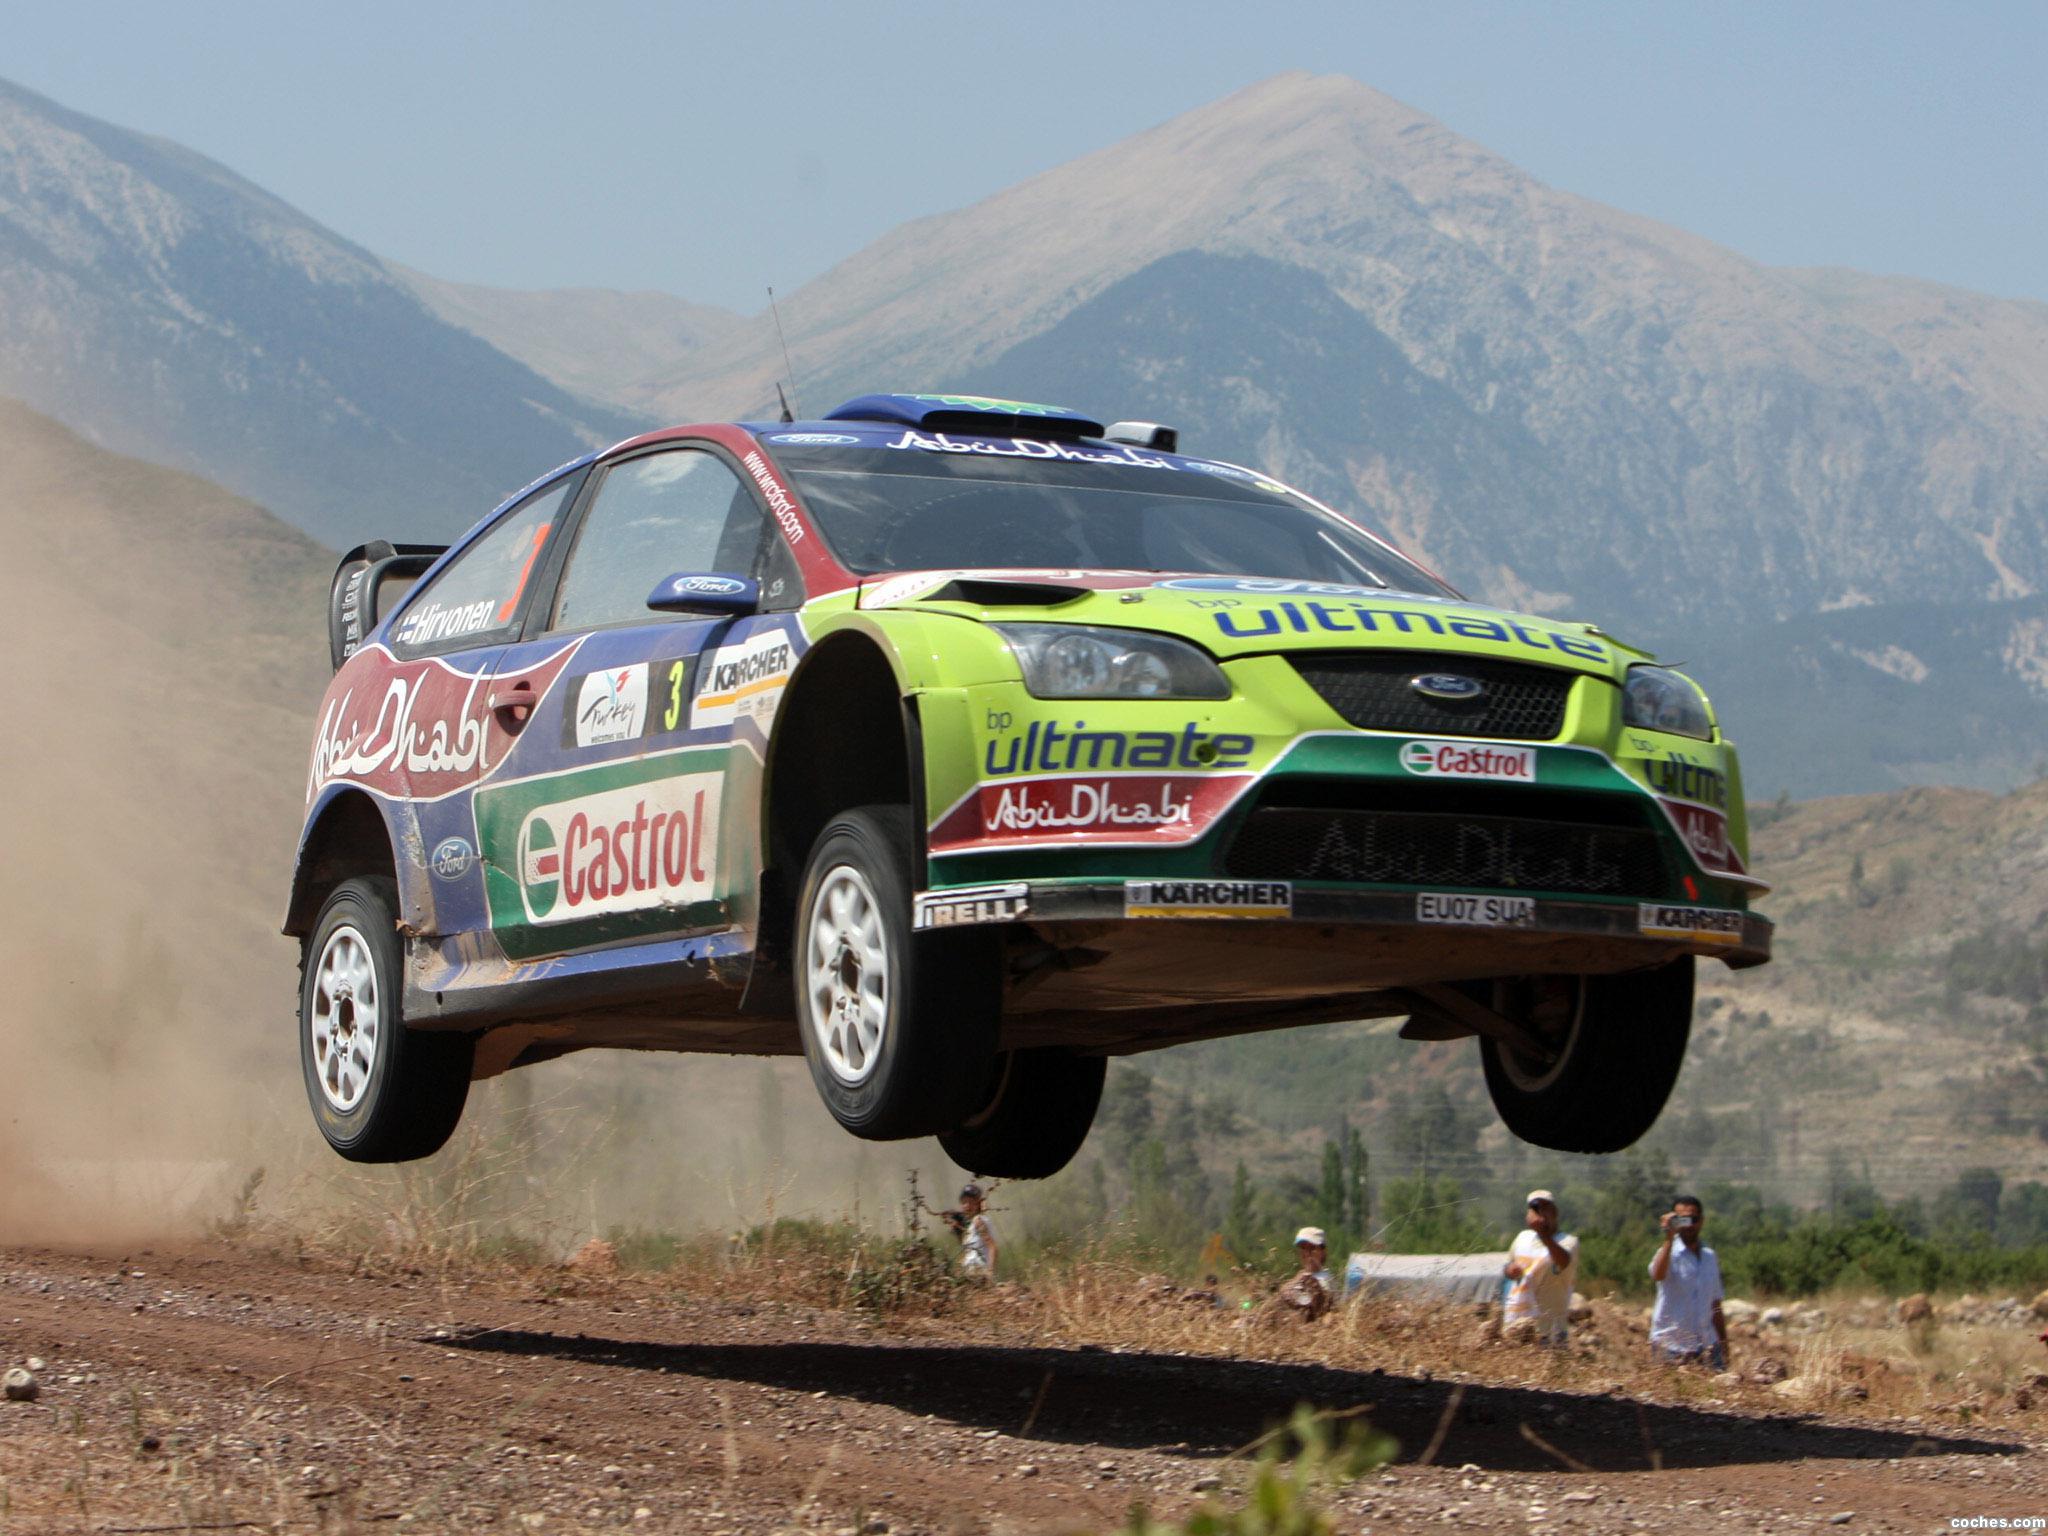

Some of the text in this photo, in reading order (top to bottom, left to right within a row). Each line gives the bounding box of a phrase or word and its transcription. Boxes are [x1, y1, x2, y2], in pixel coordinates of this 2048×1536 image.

[886, 430, 1179, 471] Abu Dhabi
[744, 451, 804, 544] www.wrcford.com
[686, 579, 733, 592] Ford
[1188, 598, 1242, 609] bp
[410, 600, 495, 645] Hirvonen
[1214, 601, 1609, 664] ultimate
[665, 661, 684, 731] 3
[987, 709, 1012, 734] bp
[986, 720, 1254, 774] ultimate
[1437, 746, 1528, 777] Castrol
[986, 782, 1193, 831] Abu Dhabi
[440, 845, 466, 873] Ford
[562, 790, 706, 907] Castrol
[1421, 897, 1477, 919] EU07
